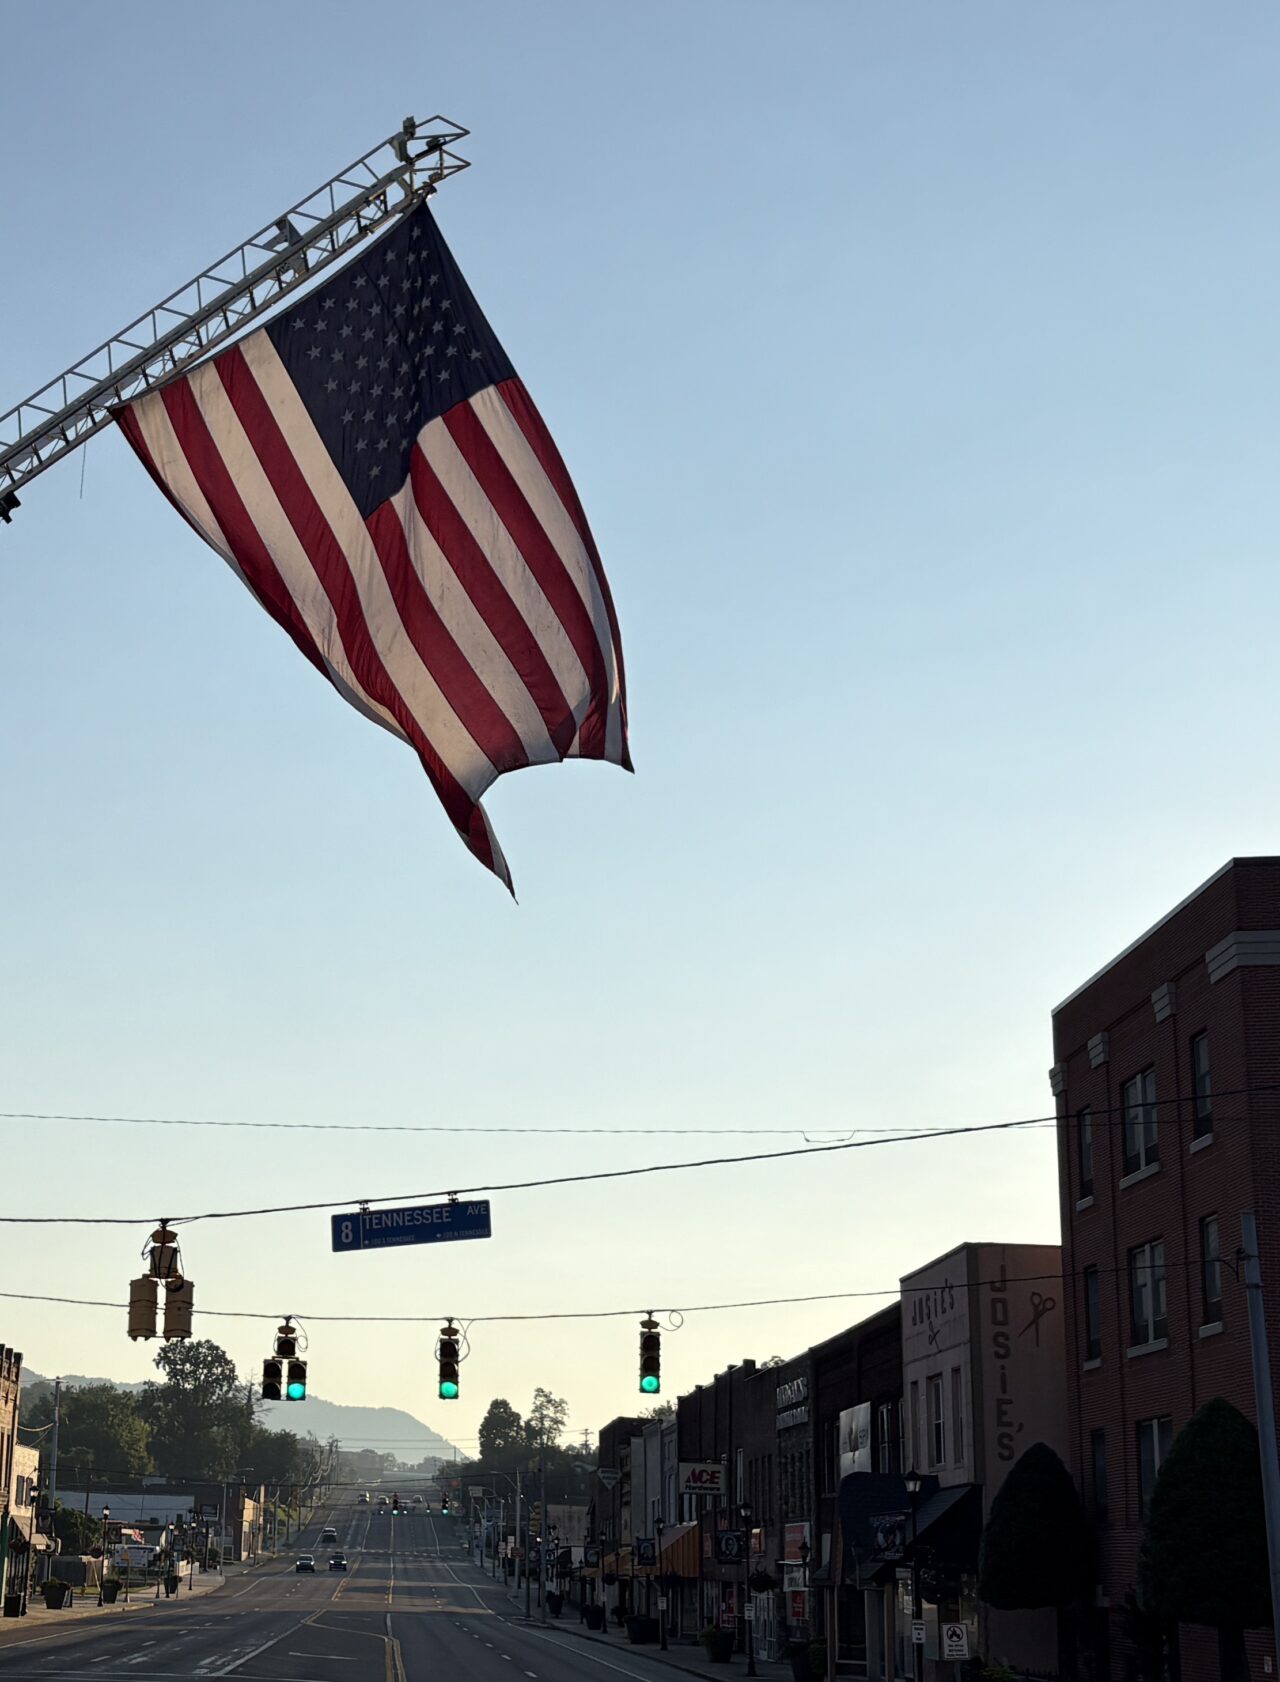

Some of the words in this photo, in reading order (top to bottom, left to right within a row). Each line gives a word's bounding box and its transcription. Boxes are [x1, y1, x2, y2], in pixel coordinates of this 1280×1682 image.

[364, 1208, 452, 1230] TENNESSEE
[466, 1204, 488, 1216] AVE
[341, 1221, 353, 1243] 8
[685, 1468, 721, 1484] ACE
